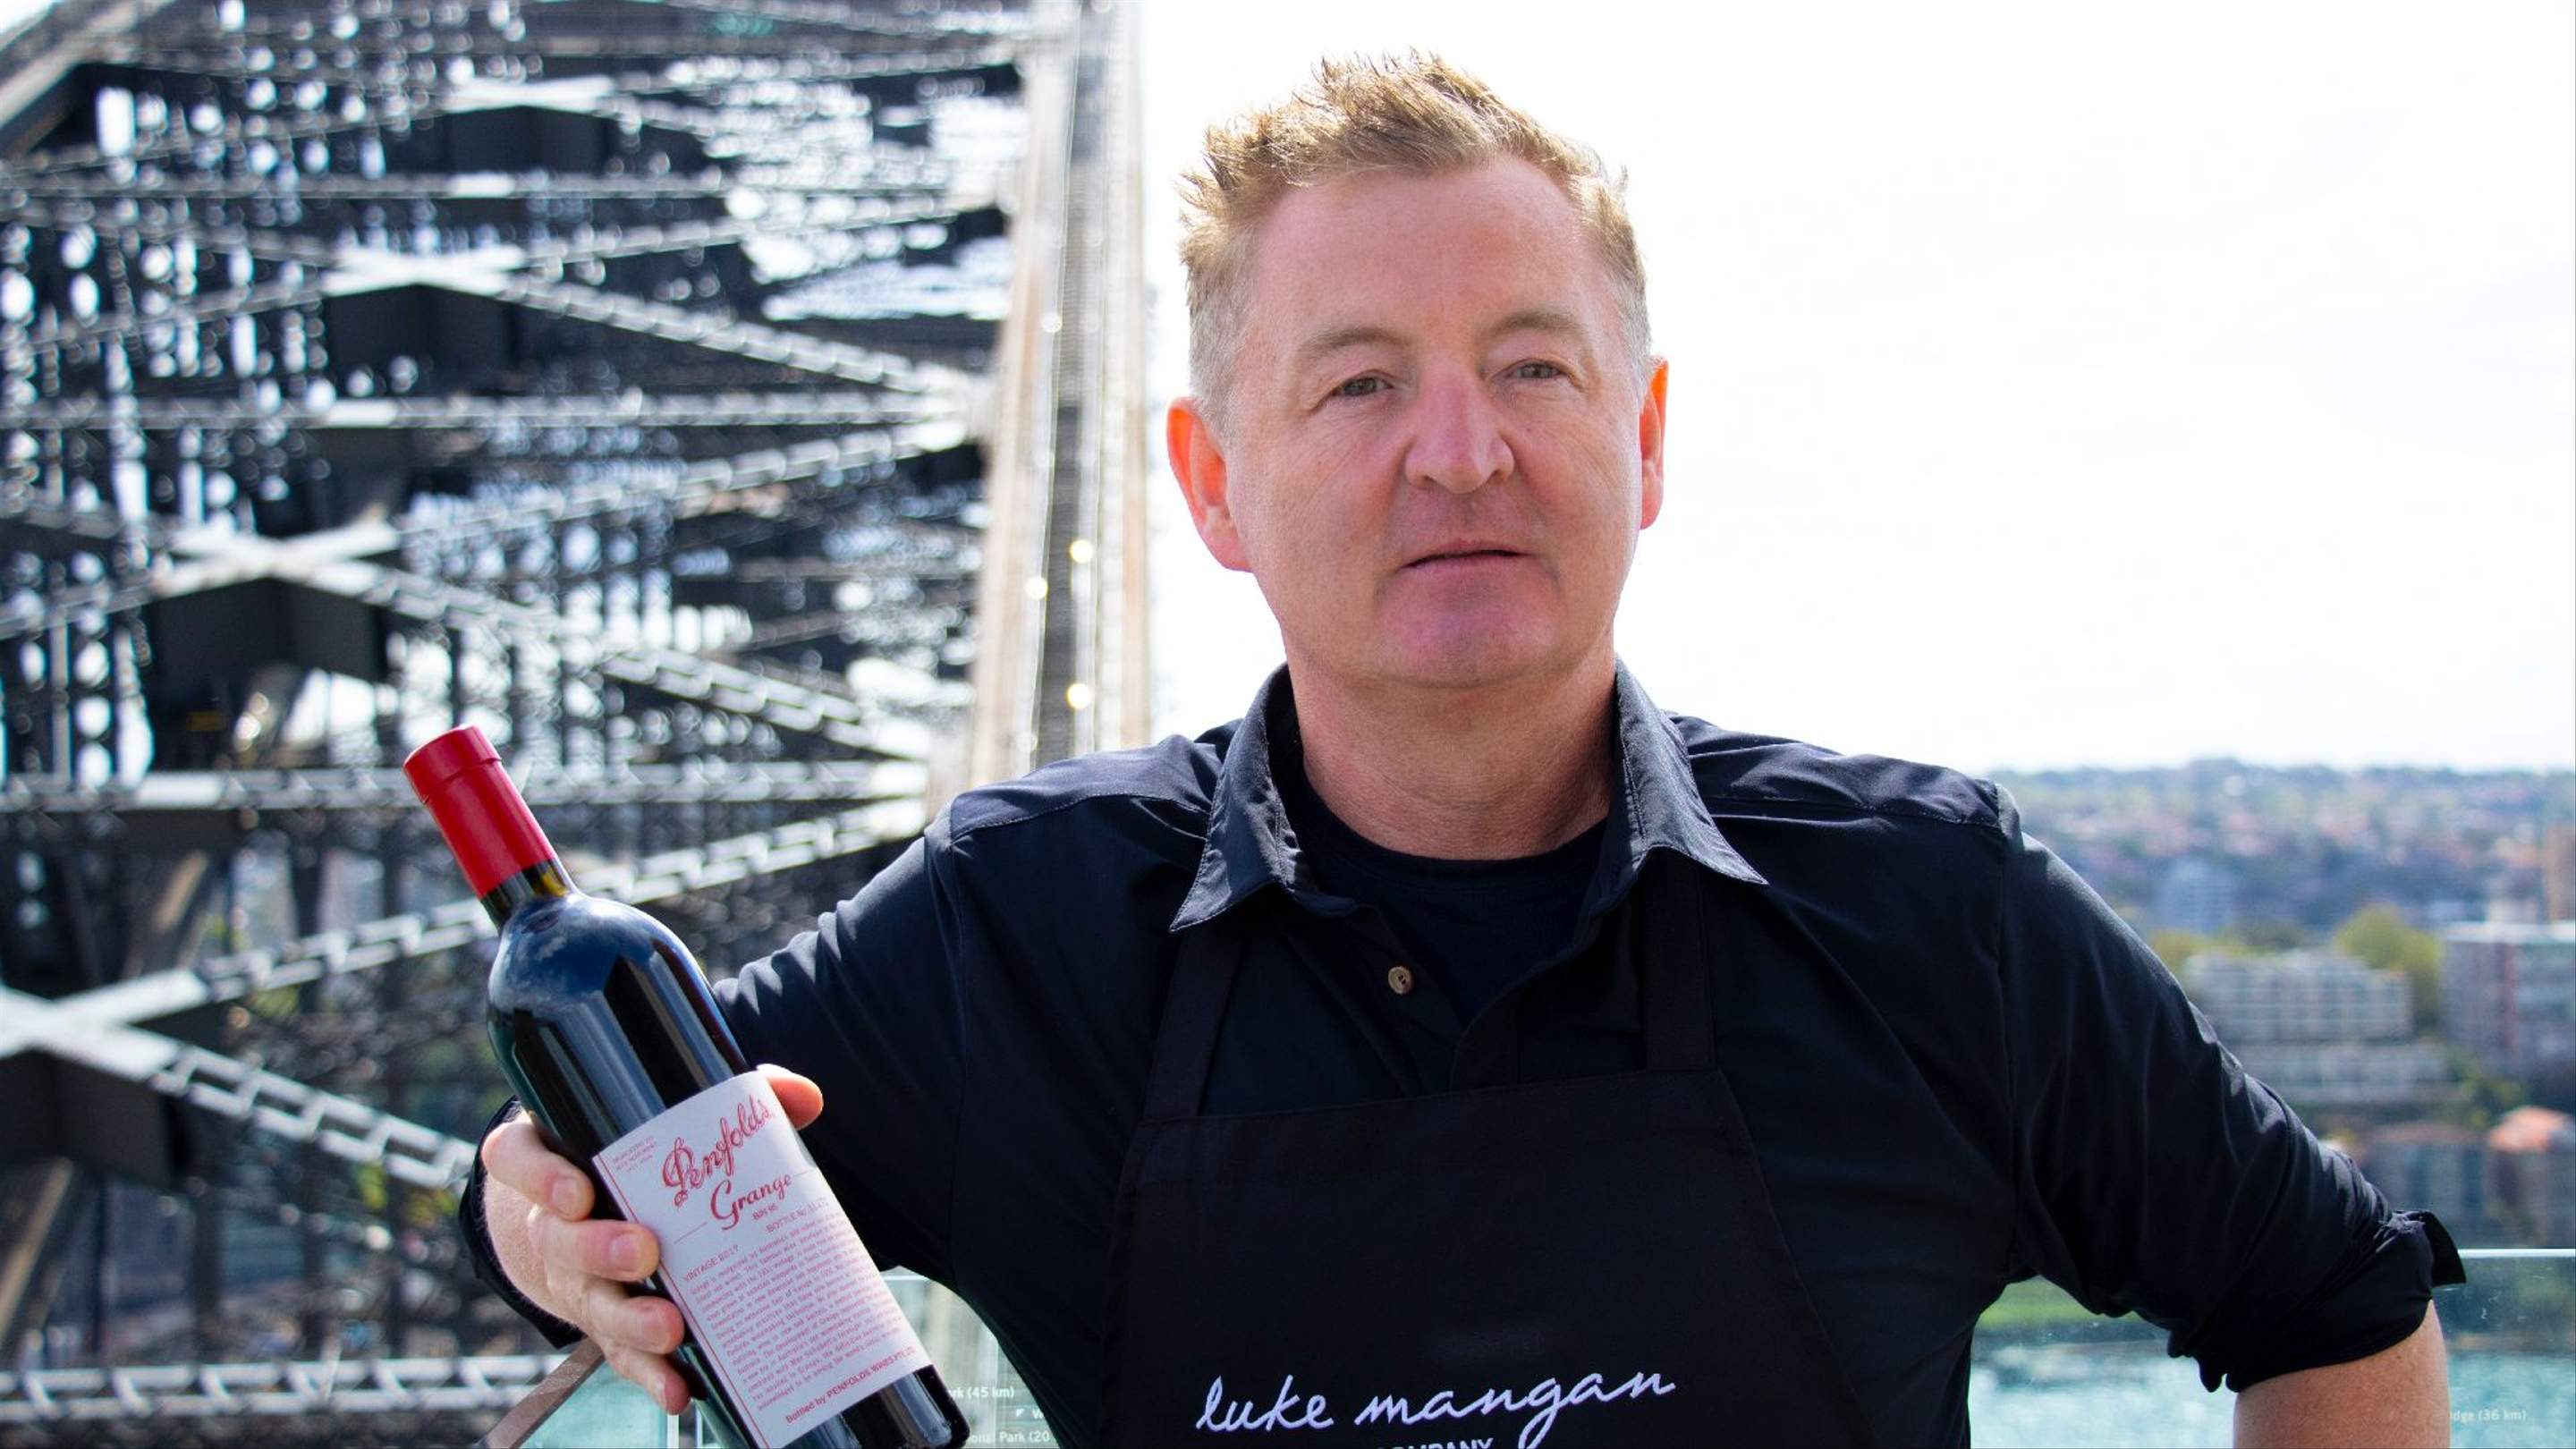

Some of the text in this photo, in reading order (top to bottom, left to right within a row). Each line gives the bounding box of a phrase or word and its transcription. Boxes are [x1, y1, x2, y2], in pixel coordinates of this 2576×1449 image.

[662, 1094, 772, 1207] Penfolds
[711, 1179, 792, 1231] Grange
[682, 1257, 718, 1282] VINTAGE
[785, 1402, 816, 1424] Bottled
[815, 1395, 826, 1406] by
[826, 1368, 872, 1399] PENFOLDS
[967, 1385, 989, 1399] (45
[1196, 1371, 1676, 1449] luke mangan
[999, 1432, 1026, 1444] Park
